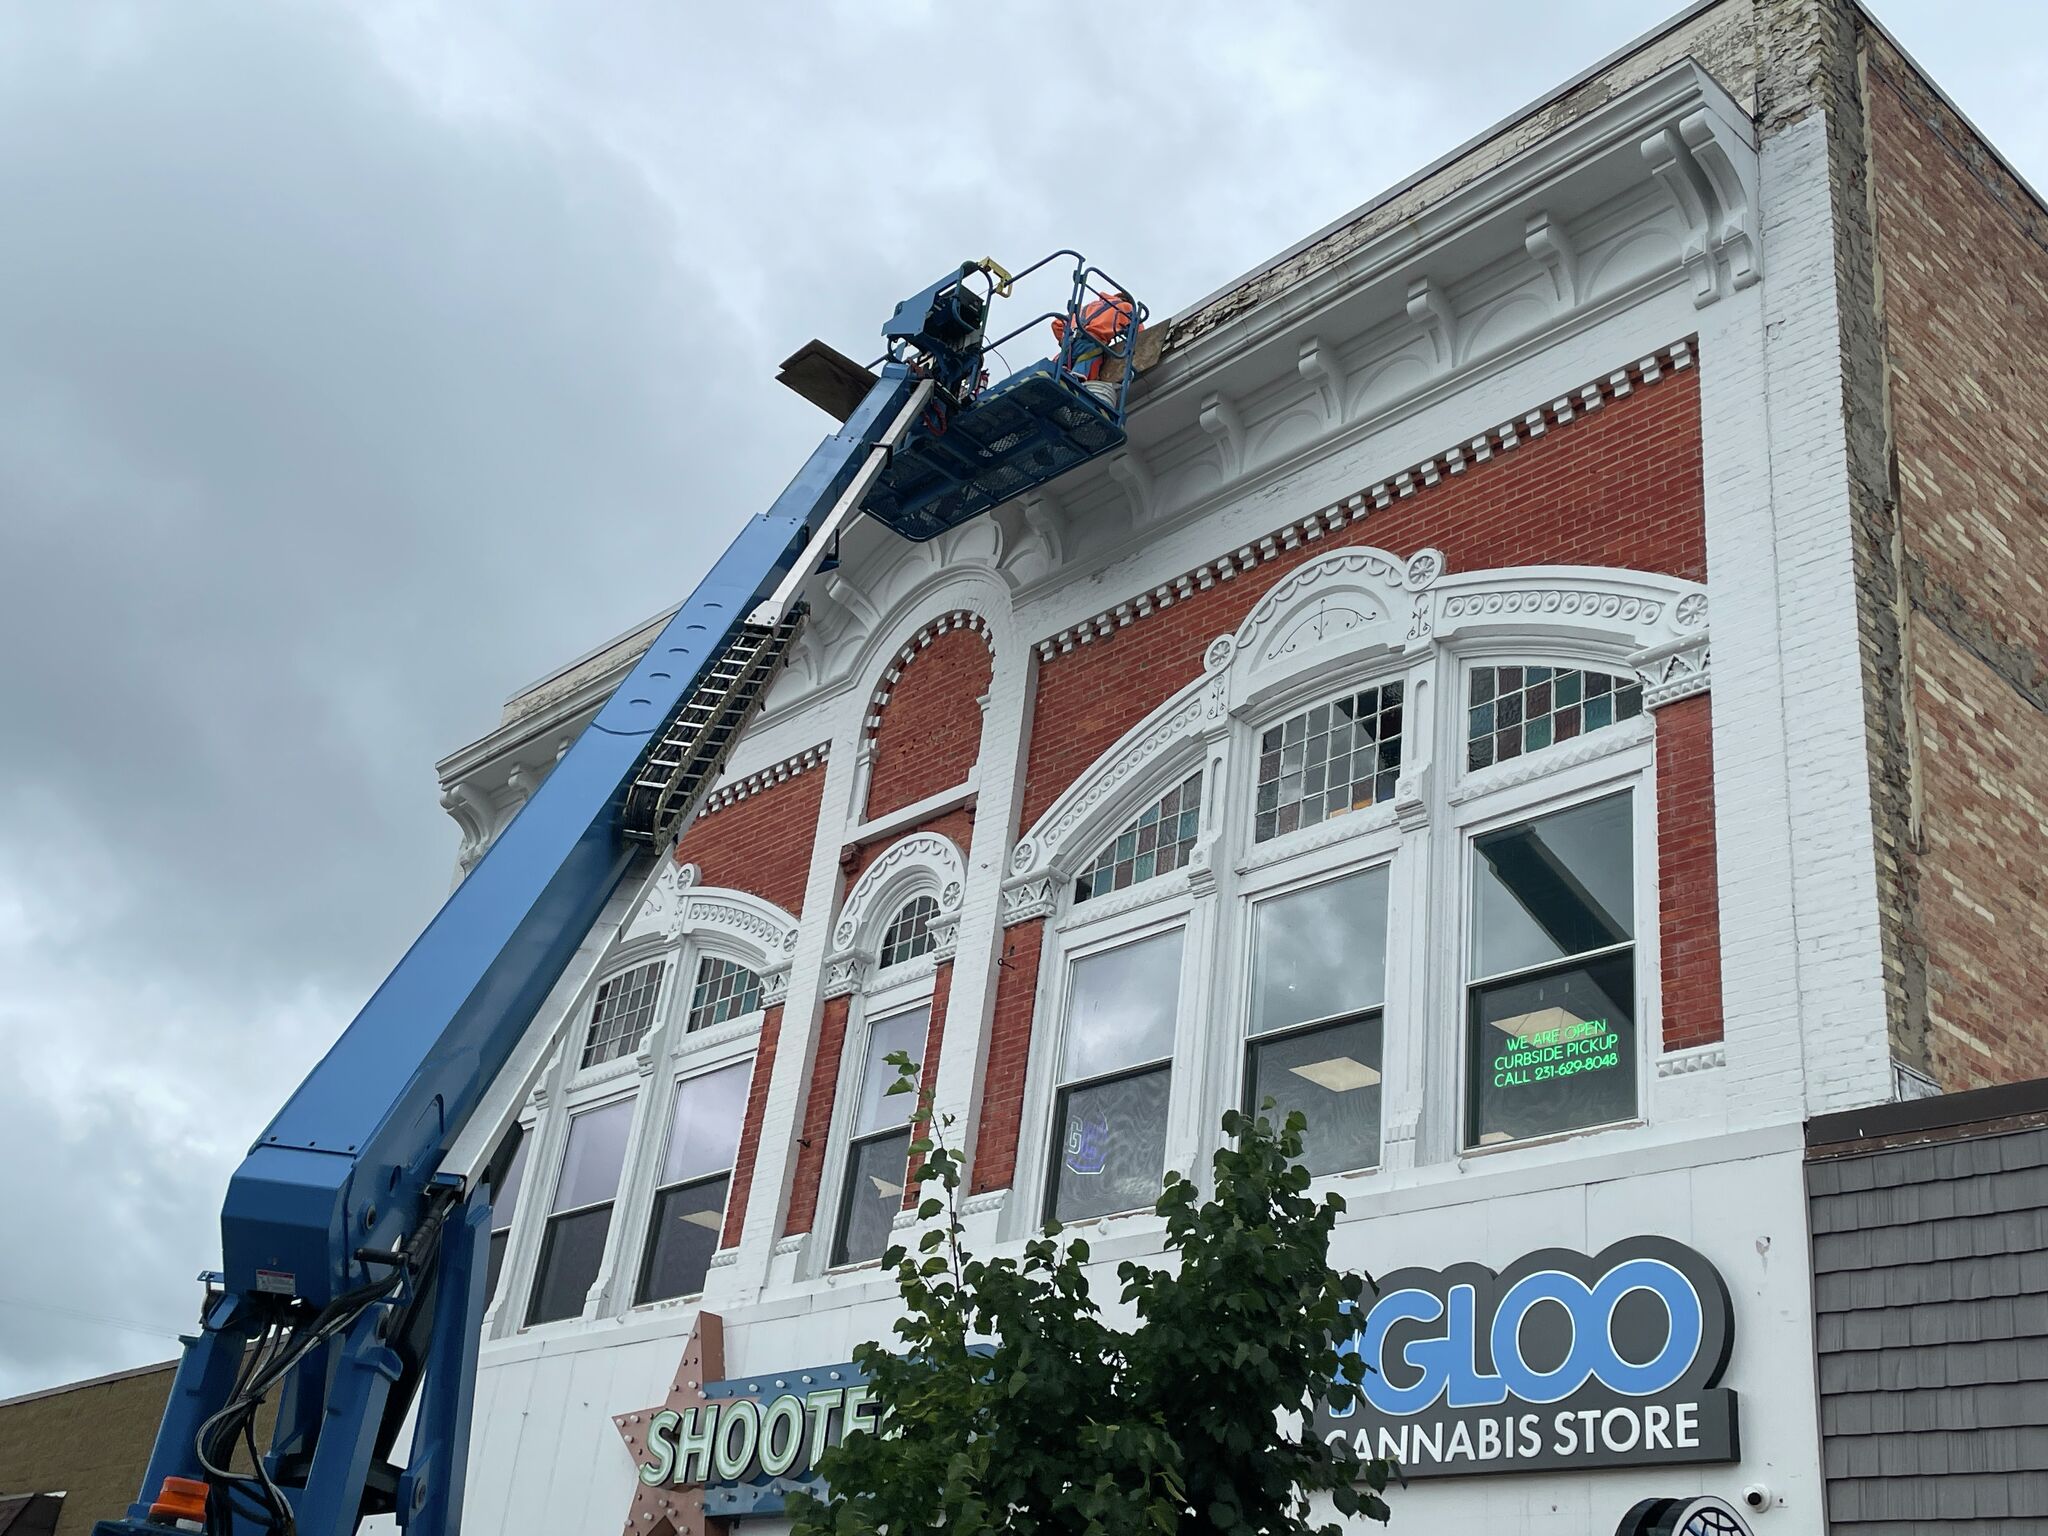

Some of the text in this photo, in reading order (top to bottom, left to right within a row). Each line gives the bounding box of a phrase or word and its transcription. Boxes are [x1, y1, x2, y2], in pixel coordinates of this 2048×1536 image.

[1494, 1034, 1618, 1071] CURBSIDE PICKUP
[1506, 1018, 1607, 1052] WE ARE OPEN
[1494, 1052, 1618, 1088] CALL 231-629-8048
[639, 1384, 900, 1488] SHOOTE
[1552, 1401, 1701, 1456] STORE
